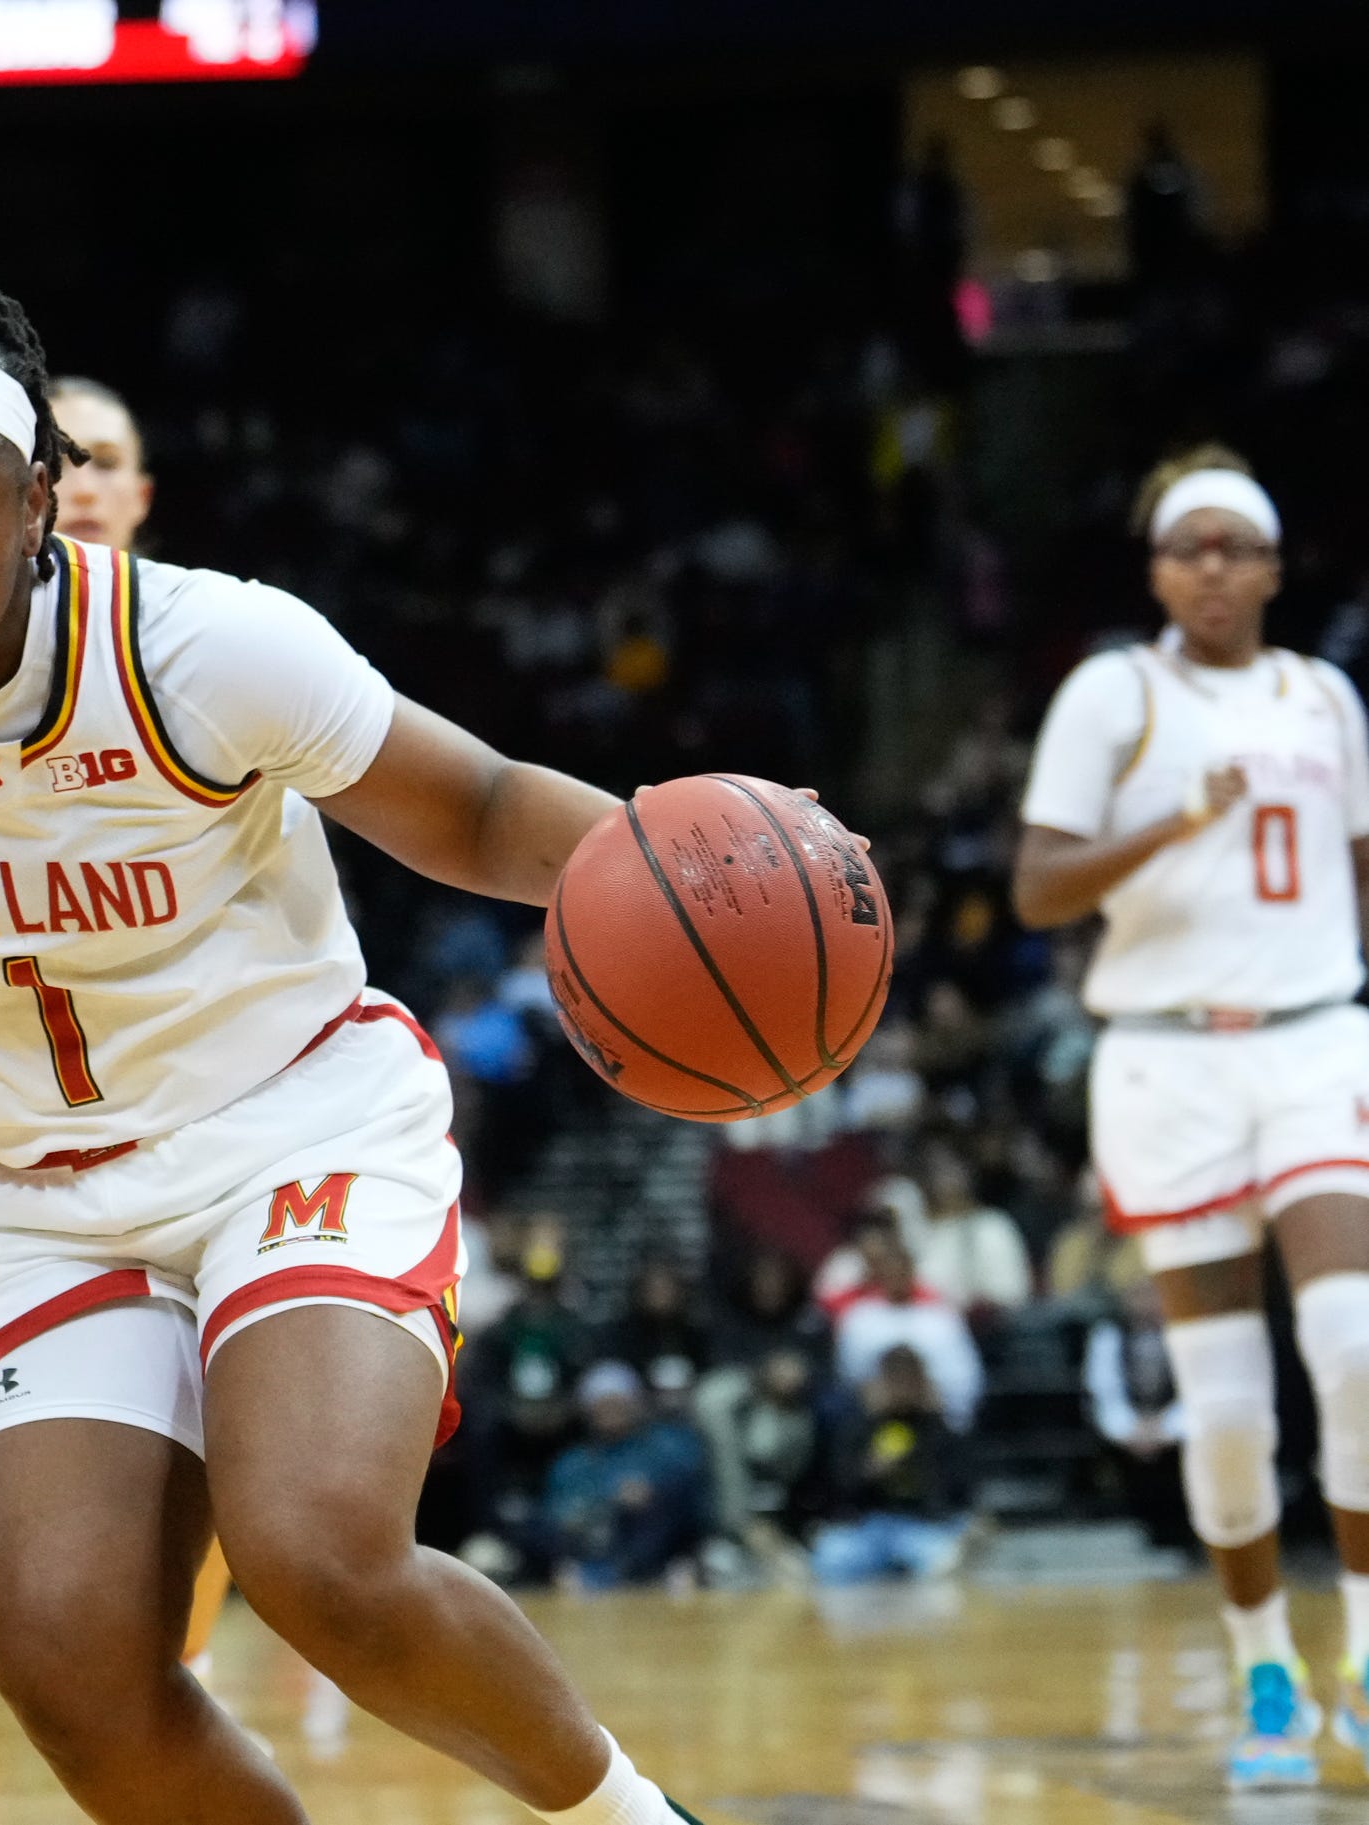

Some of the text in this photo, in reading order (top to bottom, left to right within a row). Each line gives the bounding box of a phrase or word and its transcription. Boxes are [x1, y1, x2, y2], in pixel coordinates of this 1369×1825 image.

[1251, 804, 1300, 903] 0
[2, 955, 105, 1109] 1
[258, 1172, 360, 1245] M
